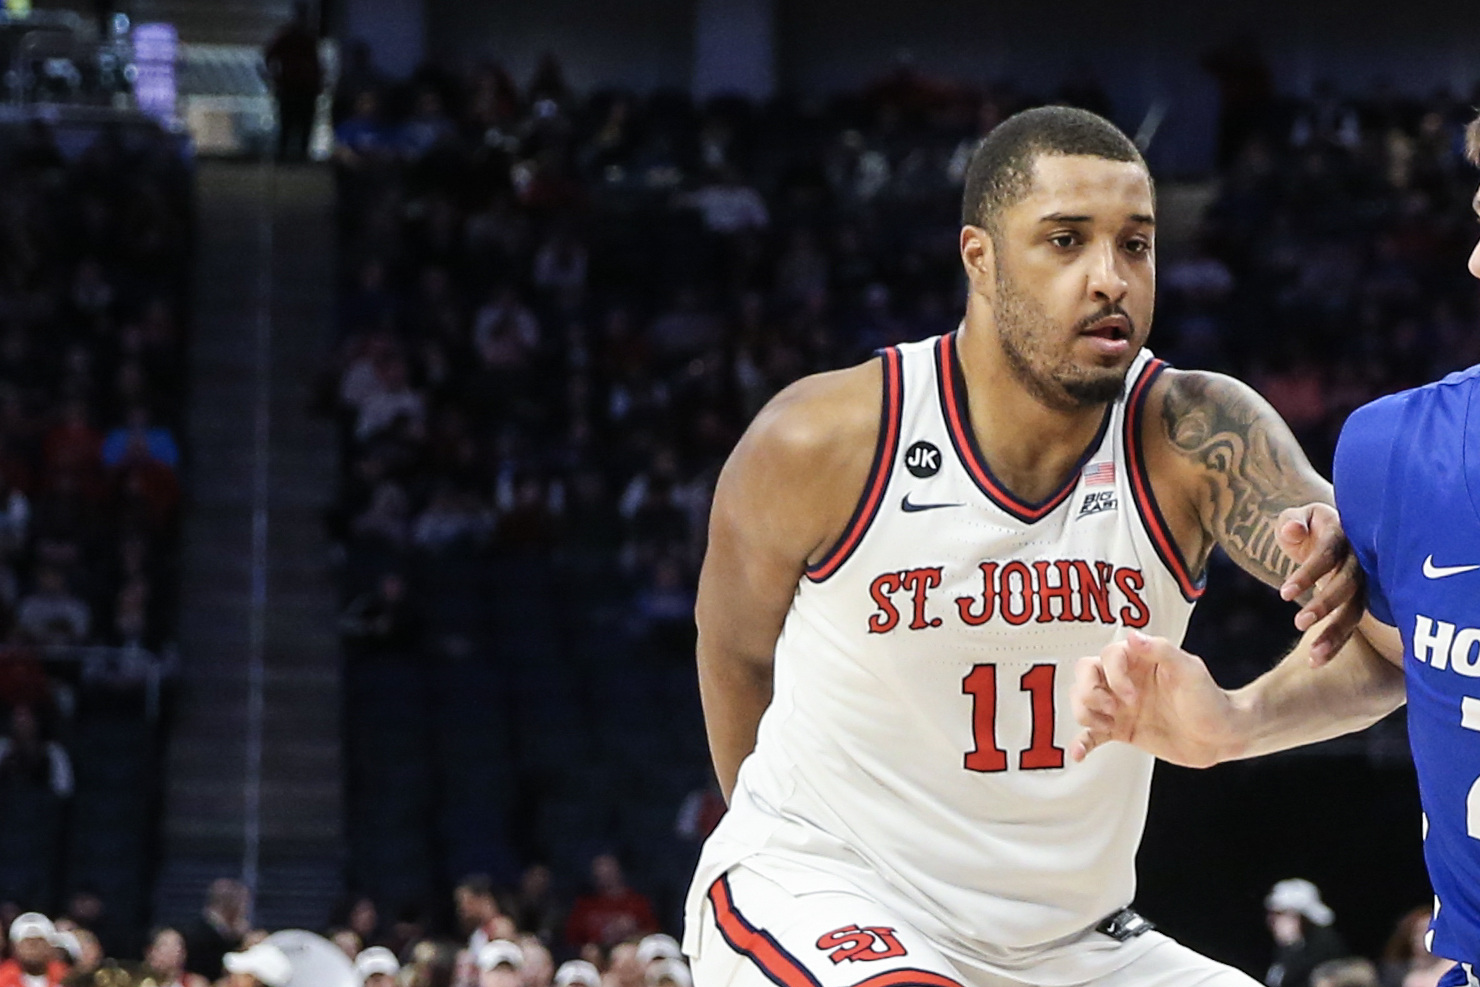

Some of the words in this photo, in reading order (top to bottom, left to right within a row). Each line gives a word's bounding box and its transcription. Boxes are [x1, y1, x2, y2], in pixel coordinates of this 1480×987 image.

[907, 447, 938, 470] JK
[868, 566, 944, 634] ST.
[955, 560, 1151, 629] JOHN'S
[961, 663, 1065, 773] 11
